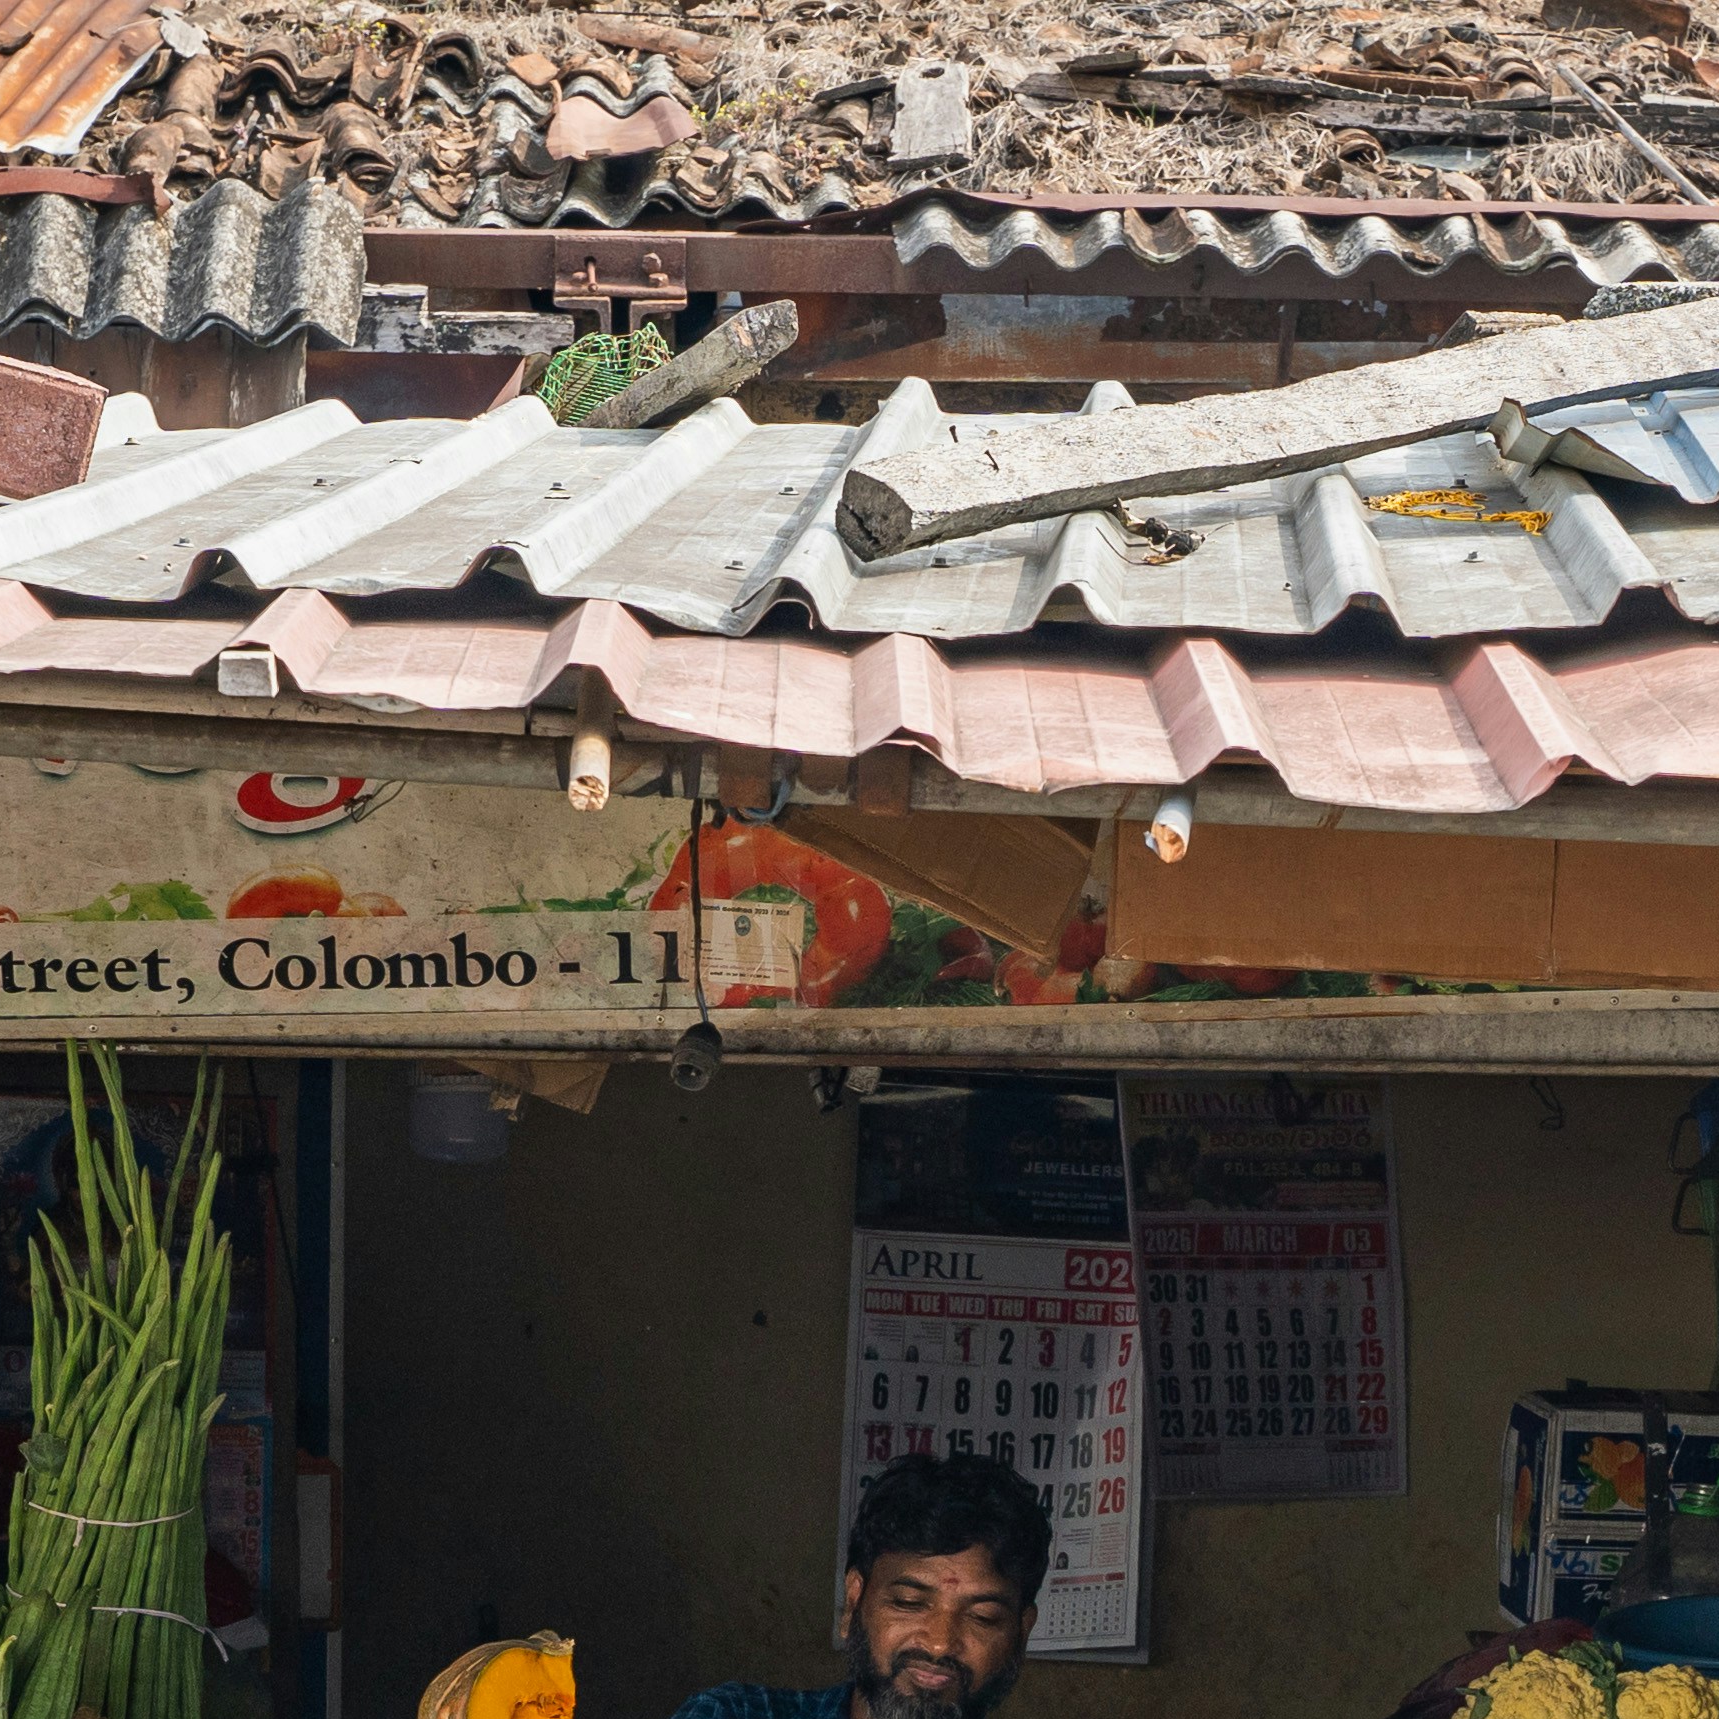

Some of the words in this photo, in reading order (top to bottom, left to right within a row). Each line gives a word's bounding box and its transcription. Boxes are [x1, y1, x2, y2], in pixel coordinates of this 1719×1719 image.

[218, 932, 539, 991] Colombo
[609, 931, 688, 985] 11
[1022, 1161, 1123, 1178] JEWELLERS
[1144, 1229, 1192, 1253] 2026
[1223, 1227, 1297, 1251] MARCH
[1344, 1228, 1372, 1250] 03
[867, 1244, 983, 1281] APRIL
[1069, 1258, 1135, 1288] 202
[1149, 1275, 1177, 1302] 30
[1186, 1276, 1208, 1302] 31
[1362, 1274, 1373, 1300] 1
[866, 1290, 903, 1311] MON
[910, 1293, 941, 1314] TUE
[948, 1295, 985, 1316] WED
[992, 1299, 1024, 1317] THU
[1036, 1300, 1061, 1319] FRI
[1075, 1302, 1105, 1322] SAT
[1159, 1309, 1172, 1335] 2
[1192, 1309, 1205, 1336] 3
[1225, 1309, 1240, 1335] 4
[1257, 1309, 1271, 1335] 5
[1290, 1309, 1304, 1335] 6
[1327, 1309, 1338, 1334] 7
[1361, 1307, 1377, 1334] 8
[954, 1327, 972, 1362] 1
[998, 1329, 1015, 1365] 2
[1039, 1329, 1055, 1367] 3
[1080, 1333, 1096, 1368] 4
[1118, 1334, 1133, 1367] 5
[1160, 1342, 1173, 1370] 9
[1188, 1342, 1211, 1369] 10
[1224, 1342, 1245, 1368] 11
[1255, 1341, 1278, 1368] 12
[1288, 1341, 1311, 1368] 13
[1323, 1341, 1346, 1367] 14
[1357, 1340, 1384, 1367] 15
[873, 1373, 888, 1410] 6
[916, 1376, 929, 1411] 7
[955, 1377, 971, 1414] 8
[996, 1380, 1012, 1416] 9
[1031, 1382, 1059, 1419] 10
[1074, 1384, 1097, 1419] 11
[1108, 1379, 1127, 1414] 12
[1157, 1377, 1180, 1403] 16
[1191, 1377, 1212, 1403] 17
[1225, 1376, 1248, 1403] 18
[1257, 1376, 1280, 1402] 19
[1289, 1376, 1314, 1402] 20
[1325, 1376, 1347, 1401] 21
[1357, 1374, 1385, 1401] 22
[1160, 1410, 1184, 1437] 23
[1192, 1410, 1217, 1437] 24
[1226, 1409, 1252, 1436] 25
[1258, 1408, 1283, 1436] 26
[1291, 1408, 1314, 1435] 27
[1324, 1408, 1351, 1434] 28
[1358, 1408, 1388, 1434] 29
[864, 1425, 893, 1461] 13
[904, 1427, 933, 1456] 14
[946, 1429, 974, 1456] 15
[988, 1431, 1015, 1465] 16
[1030, 1434, 1055, 1469] 17
[1069, 1434, 1093, 1469] 18
[1103, 1427, 1126, 1463] 19
[1063, 1482, 1092, 1518] 25
[1098, 1478, 1126, 1514] 26
